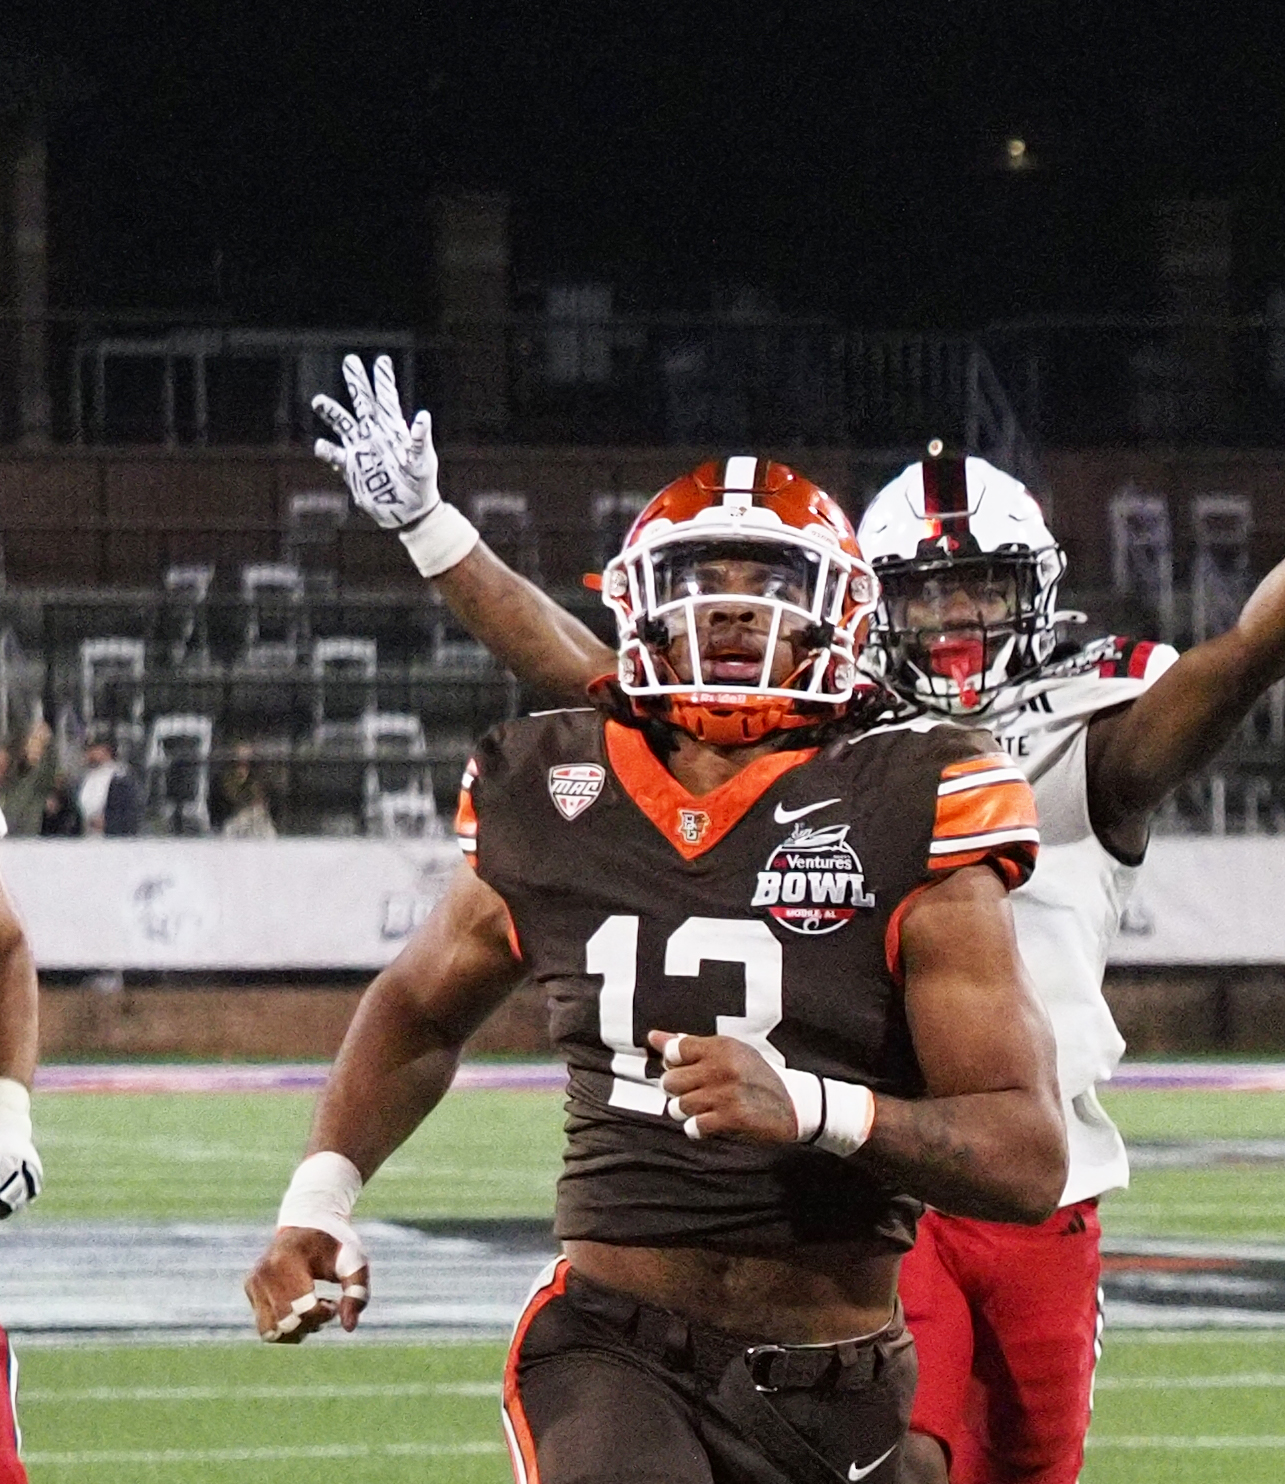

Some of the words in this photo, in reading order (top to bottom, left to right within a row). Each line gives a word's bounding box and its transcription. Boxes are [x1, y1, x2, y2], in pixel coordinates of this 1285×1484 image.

[551, 779, 599, 797] MAC
[786, 853, 852, 870] Ventures
[750, 871, 876, 908] BOWL
[585, 914, 787, 1117] 13
